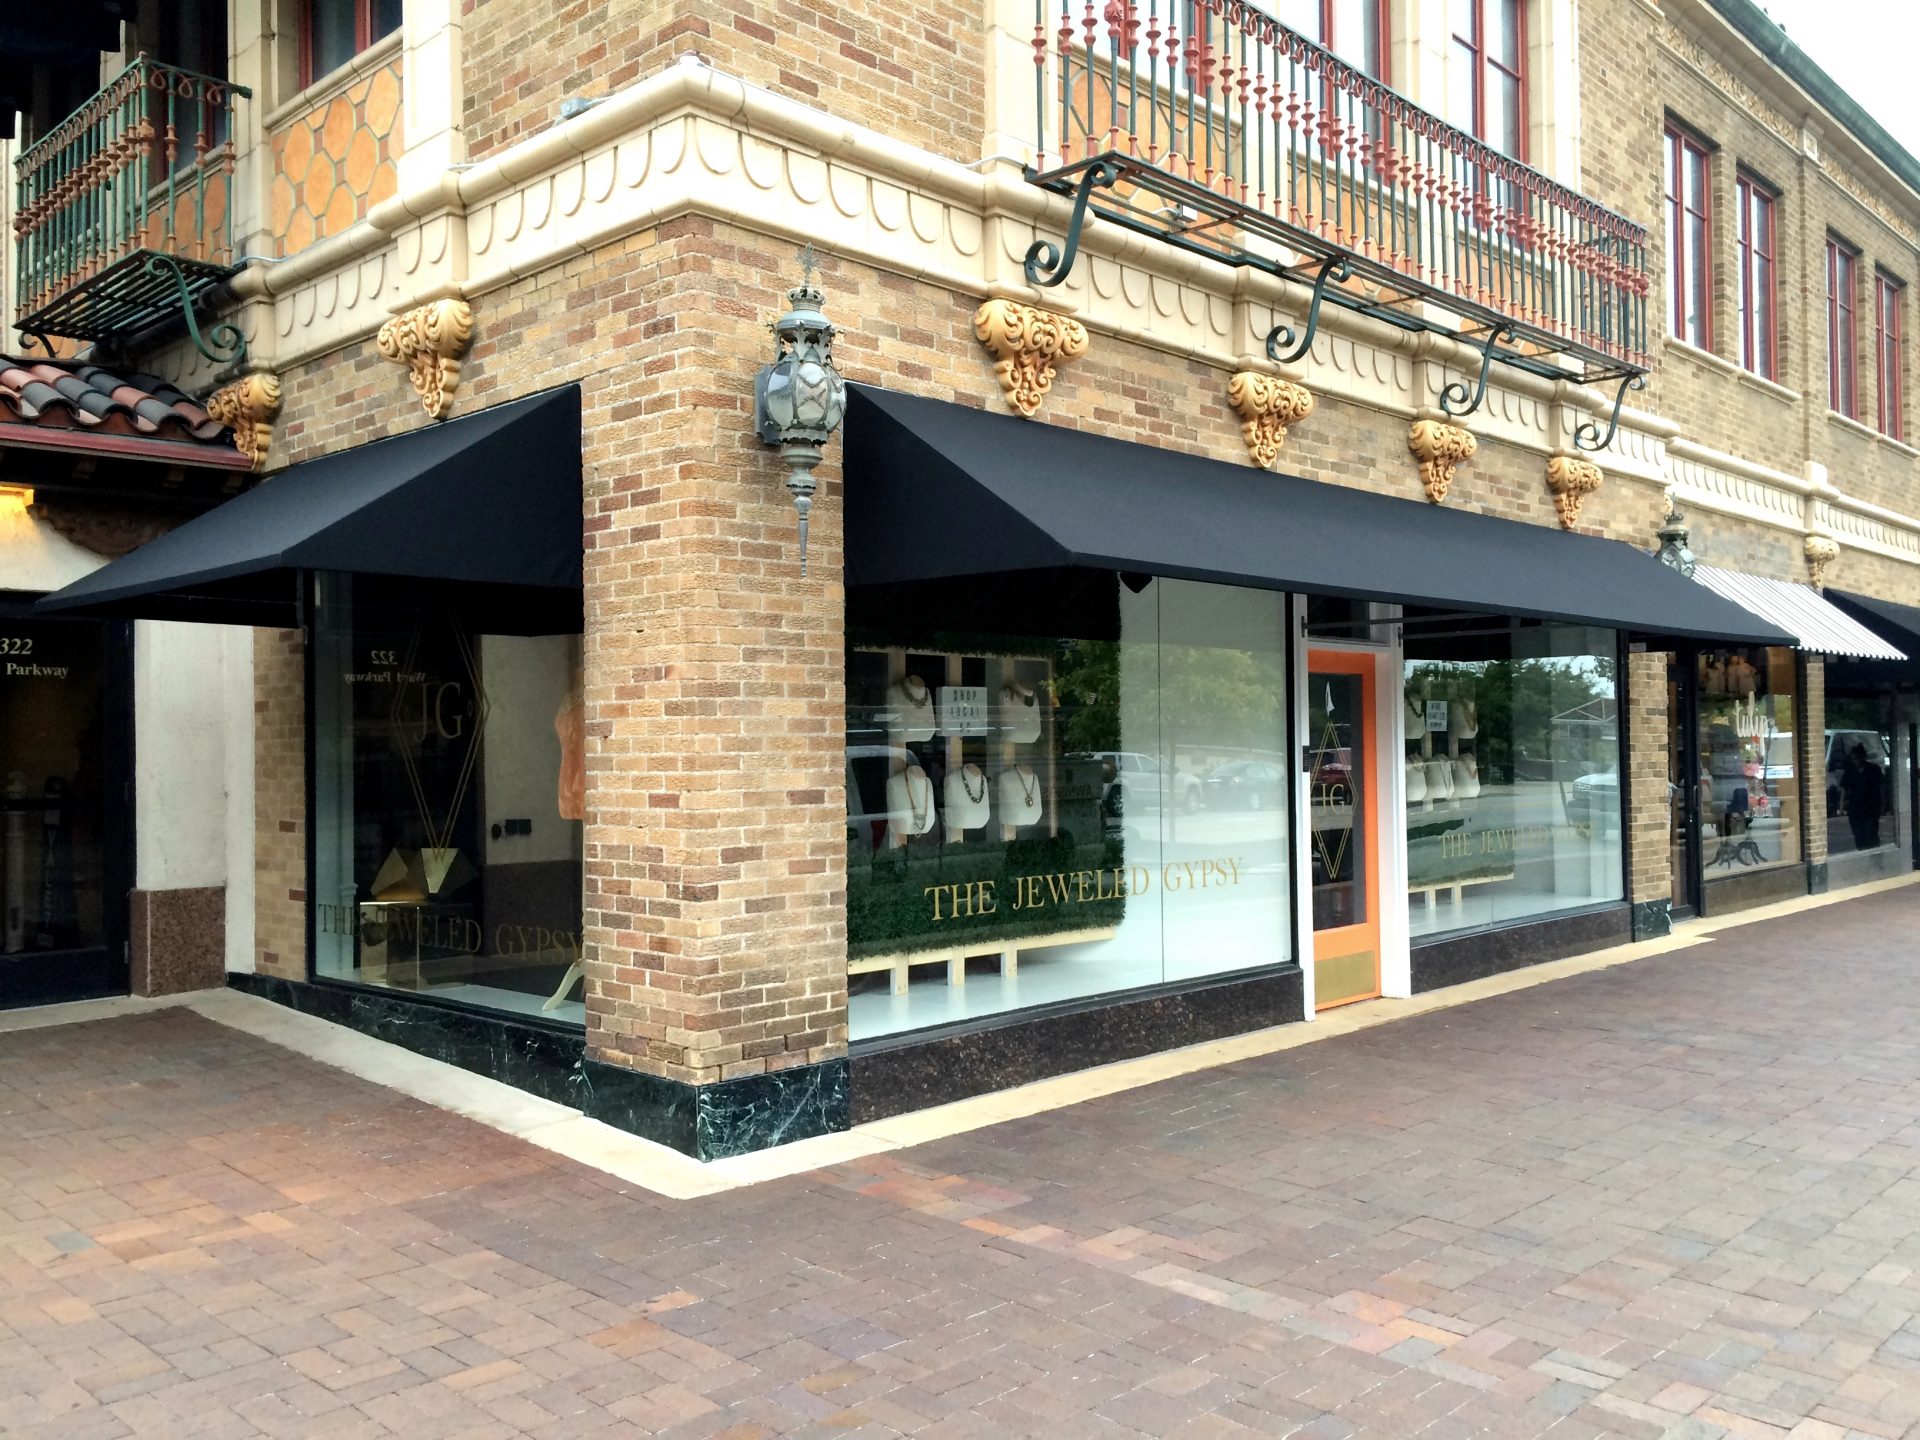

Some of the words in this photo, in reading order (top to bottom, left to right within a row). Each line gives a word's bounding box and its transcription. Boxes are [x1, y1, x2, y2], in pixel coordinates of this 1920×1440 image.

[0, 637, 33, 655] 322
[6, 662, 69, 679] Parkway
[414, 681, 462, 742] JG
[1732, 691, 1769, 756] tulip
[1320, 783, 1346, 815] JG
[1439, 832, 1473, 859] THE
[924, 879, 997, 922] THE
[1012, 864, 1150, 910] JEWELED
[1163, 856, 1243, 892] GYPSY
[495, 922, 583, 966] GYPSY
